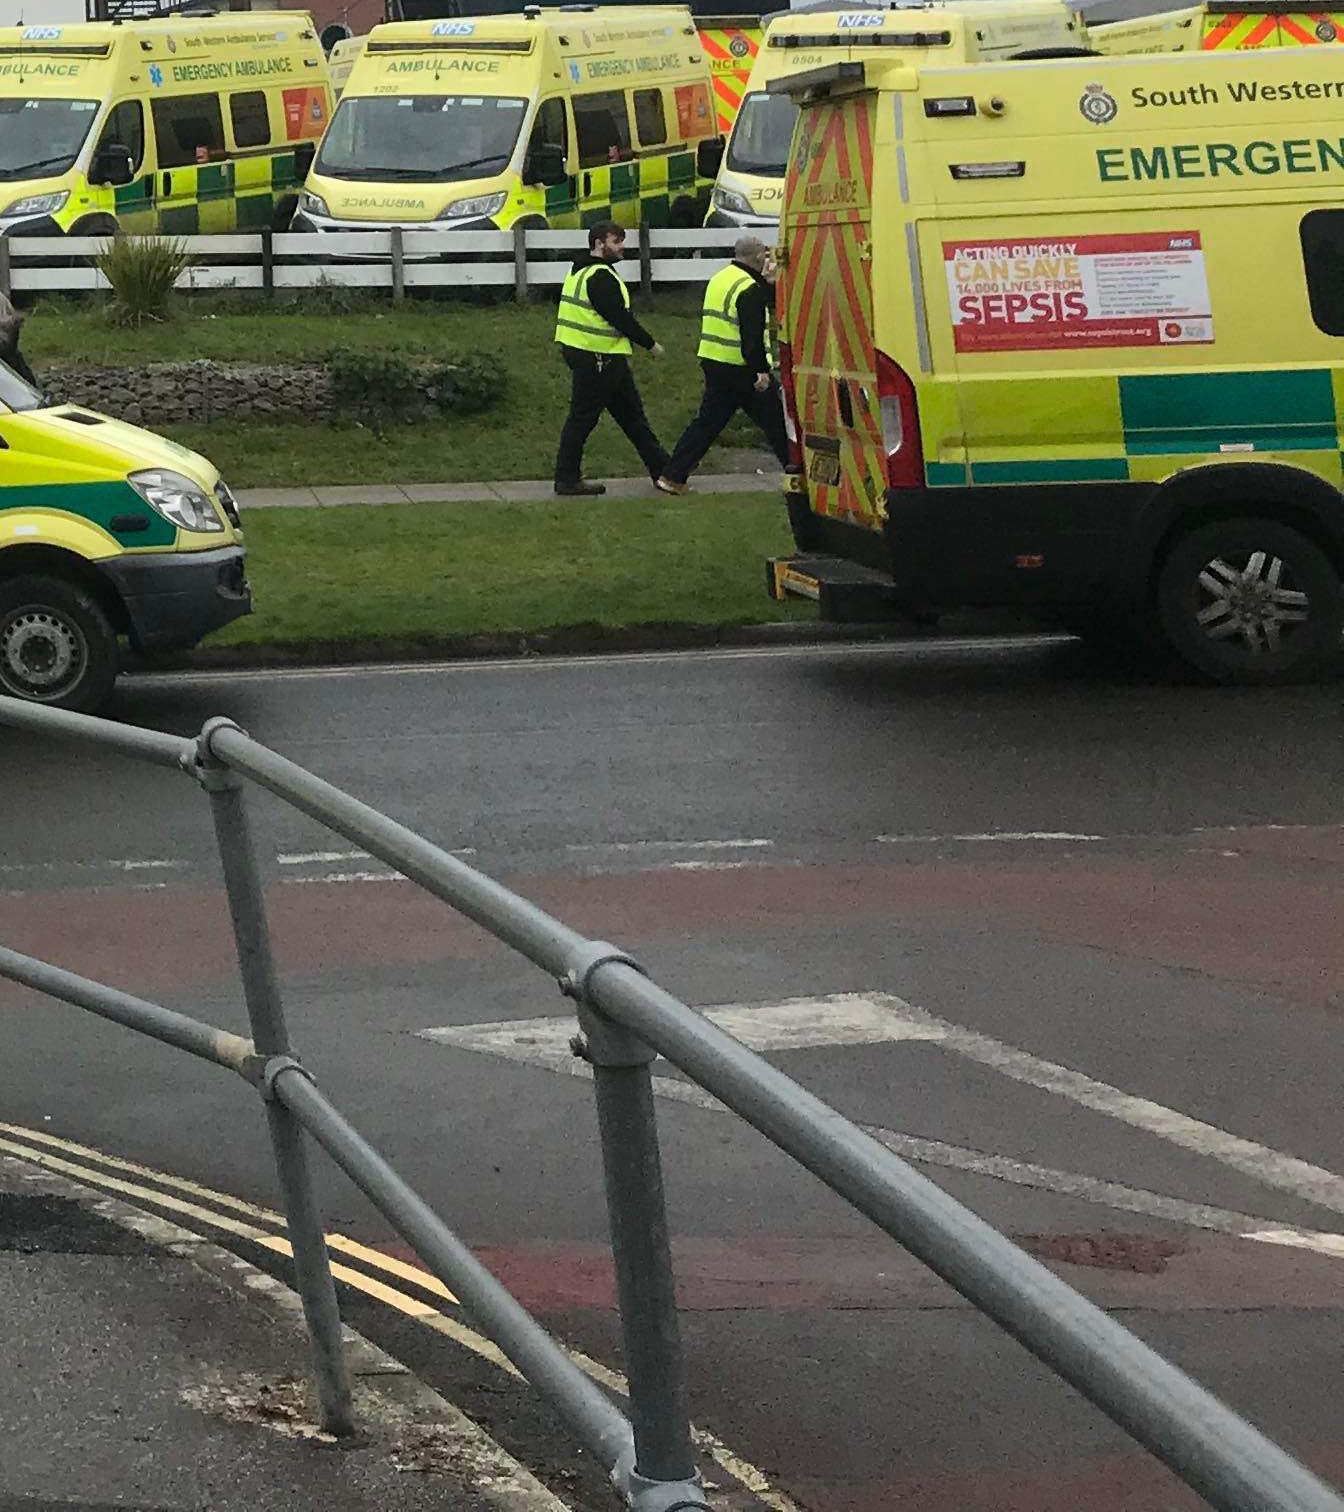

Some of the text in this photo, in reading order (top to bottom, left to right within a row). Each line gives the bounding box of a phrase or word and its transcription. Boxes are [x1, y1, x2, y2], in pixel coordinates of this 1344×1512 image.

[838, 15, 884, 27] NHS
[22, 27, 61, 40] NHS
[431, 22, 475, 36] NHS
[386, 59, 500, 73] AMBULANCE
[792, 55, 823, 65] 0504
[172, 56, 293, 81] EMERGENCY AMBULANCE
[1131, 83, 1219, 108] South
[954, 243, 1077, 261] ACTING QUICKLY
[955, 258, 1009, 281] CAN
[1014, 257, 1081, 279] SAVE
[1002, 281, 1042, 292] LIVES
[1044, 279, 1083, 290] FROM
[958, 292, 1089, 324] SEPSIS
